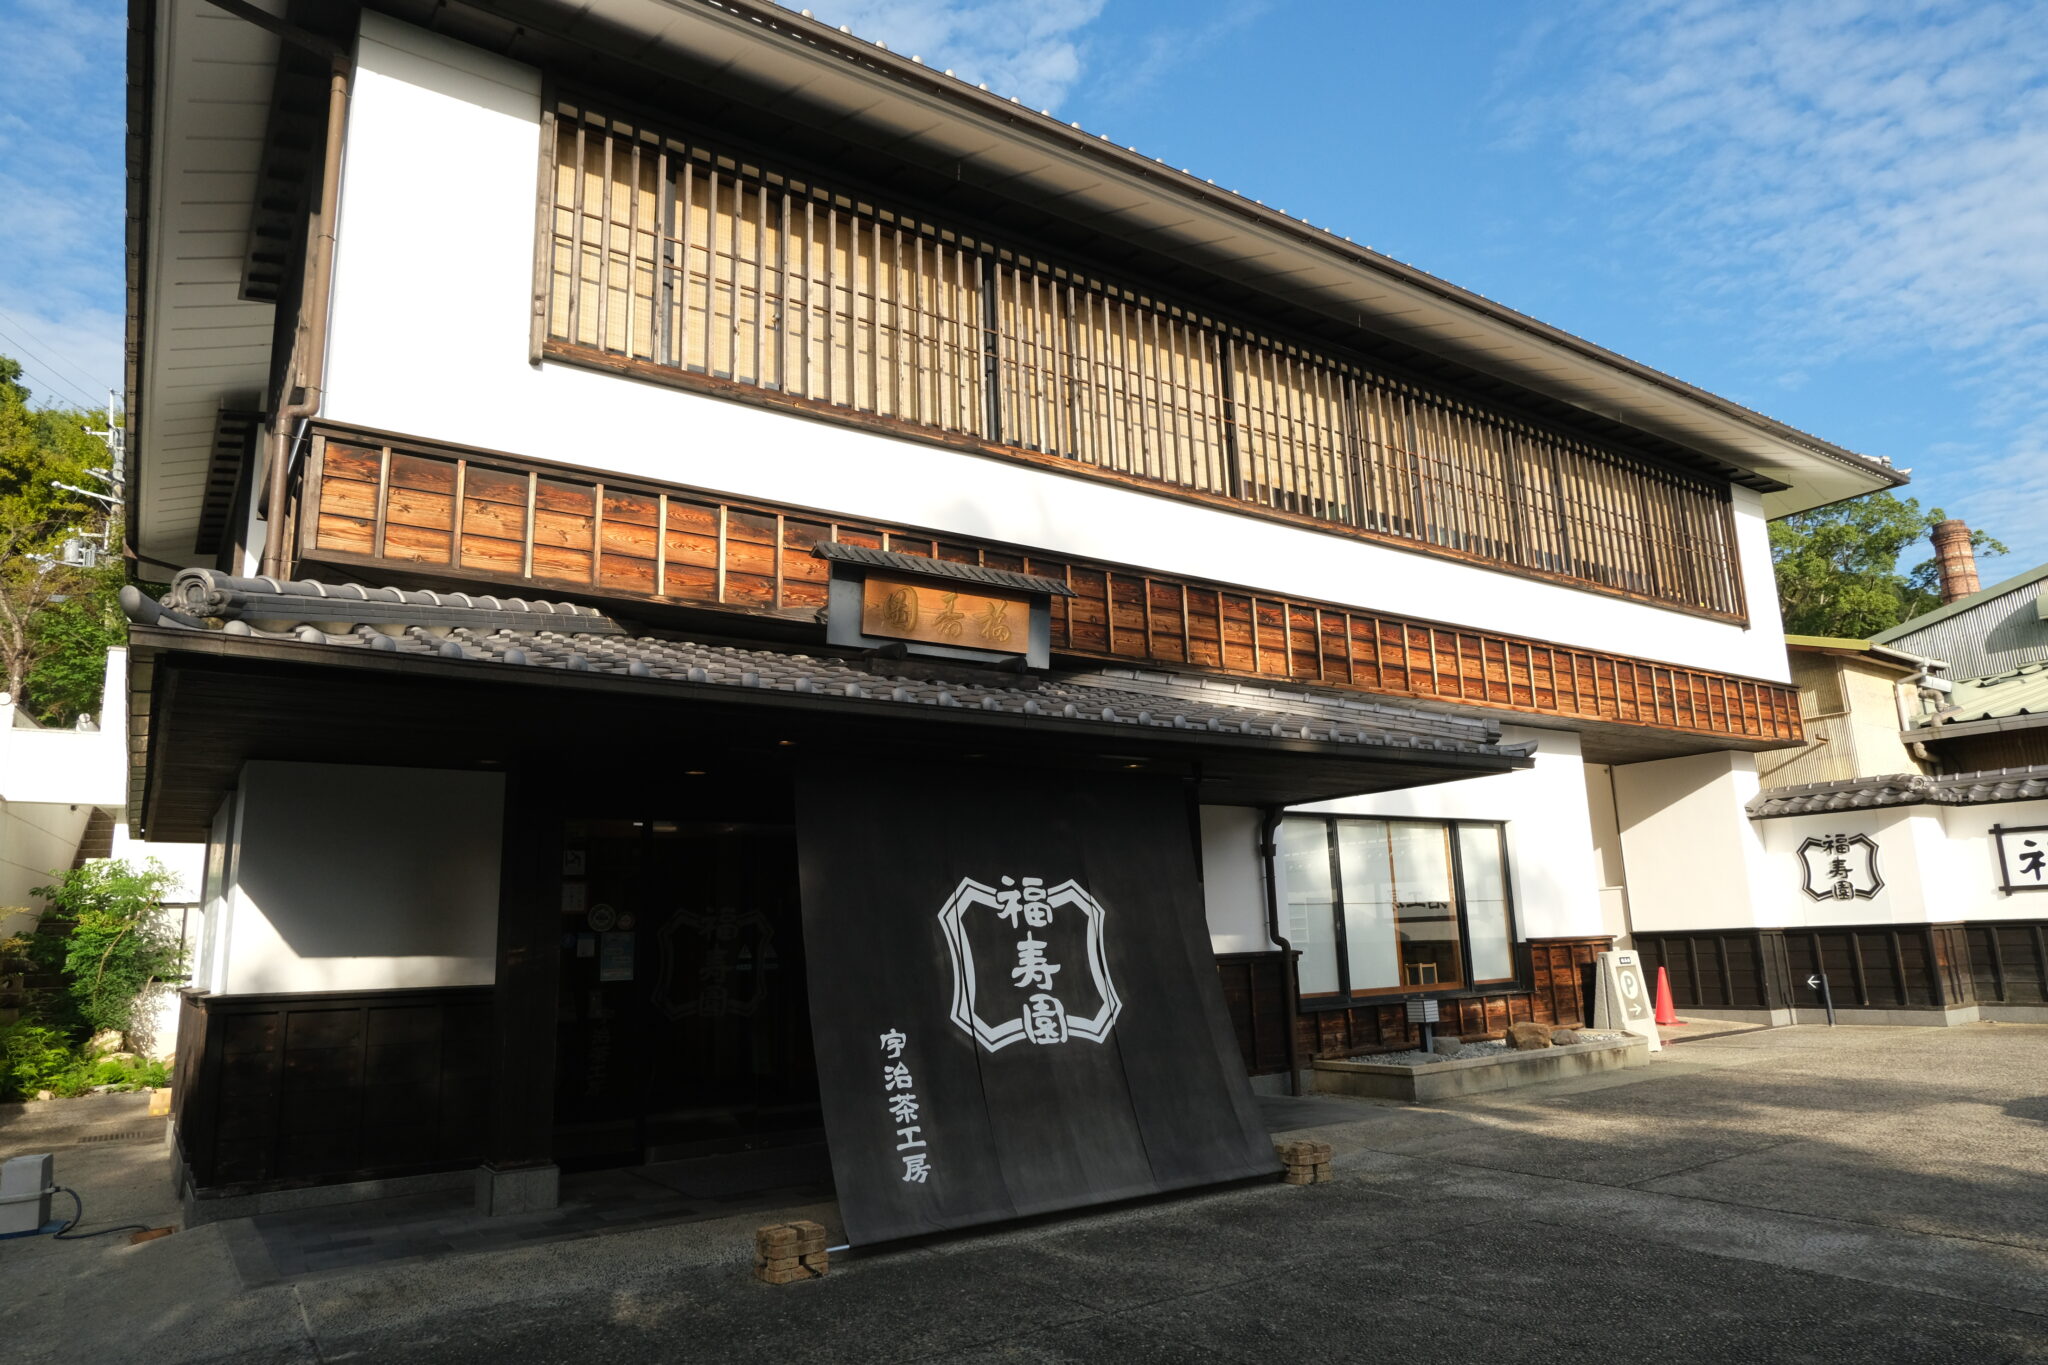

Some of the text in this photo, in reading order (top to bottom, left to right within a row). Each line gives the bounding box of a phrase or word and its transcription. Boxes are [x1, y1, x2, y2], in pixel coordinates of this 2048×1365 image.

[1822, 834, 1854, 900] 福寿園
[996, 875, 1068, 1045] 福寿園
[1623, 974, 1634, 995] P
[879, 1028, 931, 1183] 宇治茶工房
